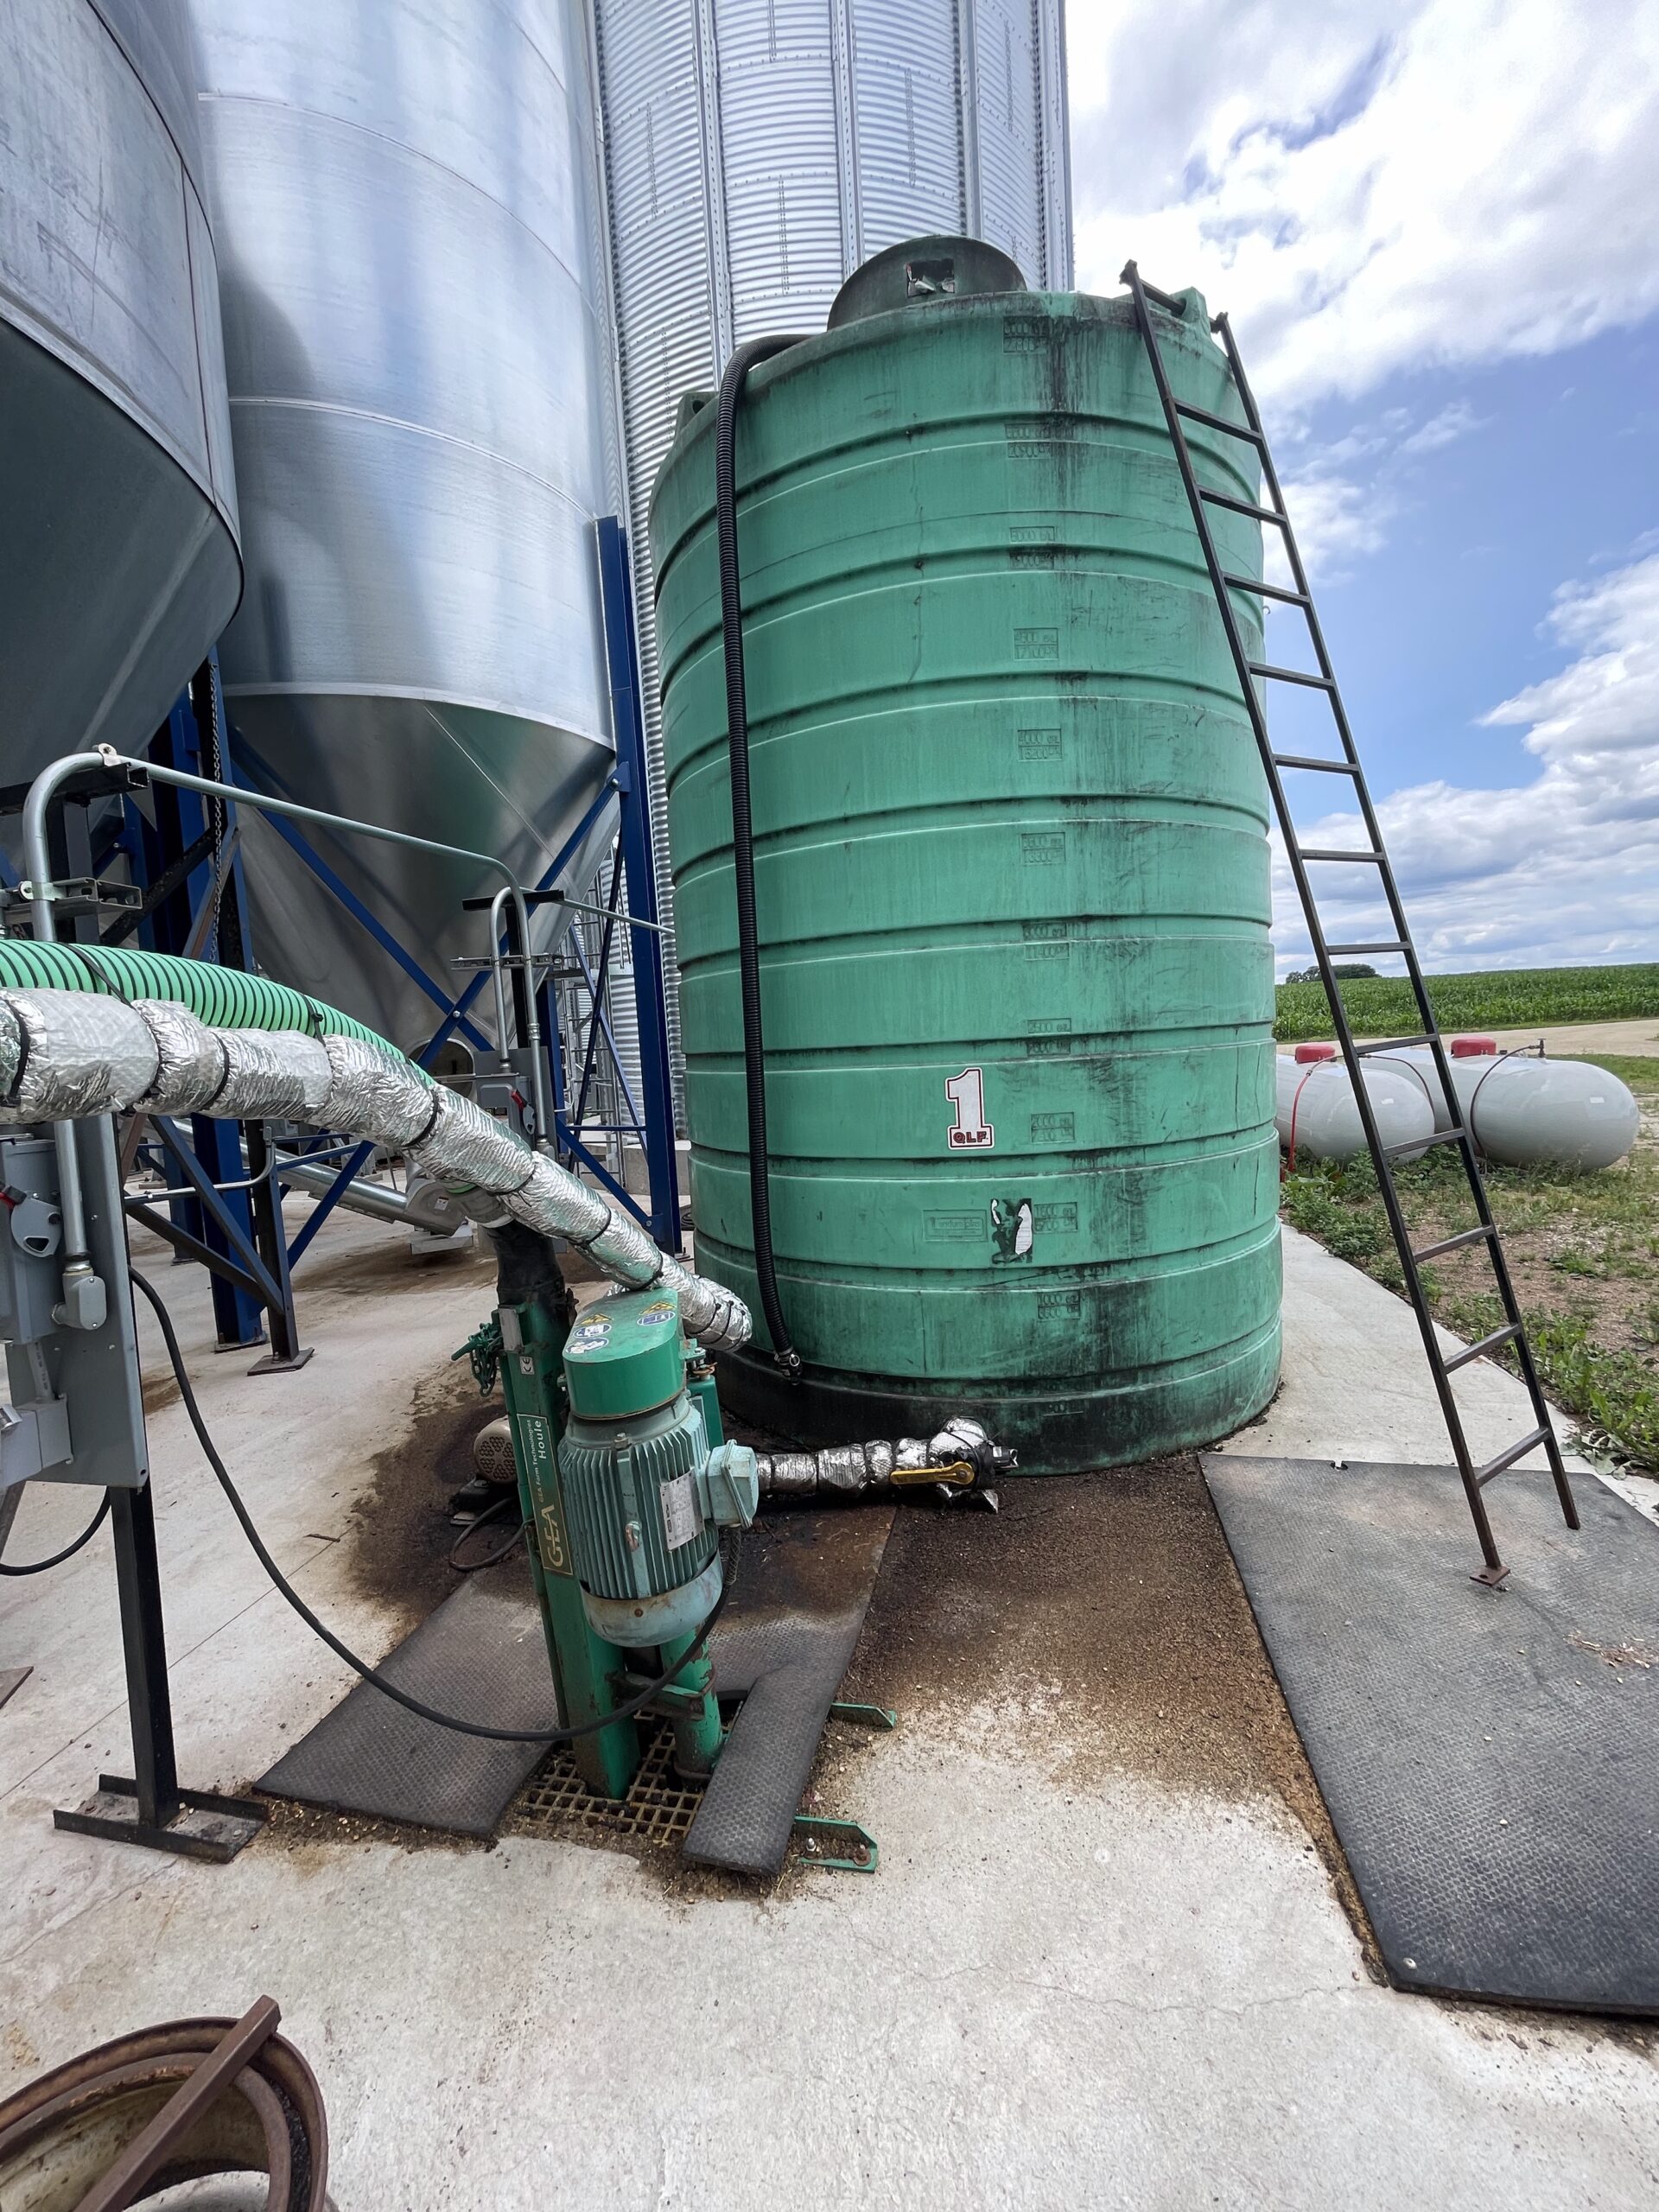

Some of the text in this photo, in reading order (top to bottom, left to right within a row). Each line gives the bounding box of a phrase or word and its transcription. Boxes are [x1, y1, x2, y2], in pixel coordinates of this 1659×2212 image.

[946, 1068, 993, 1147] 1
[953, 1131, 987, 1144] QLF
[527, 1420, 538, 1465] Technologies
[534, 1420, 547, 1459] Houle
[541, 1503, 563, 1567] GEA
